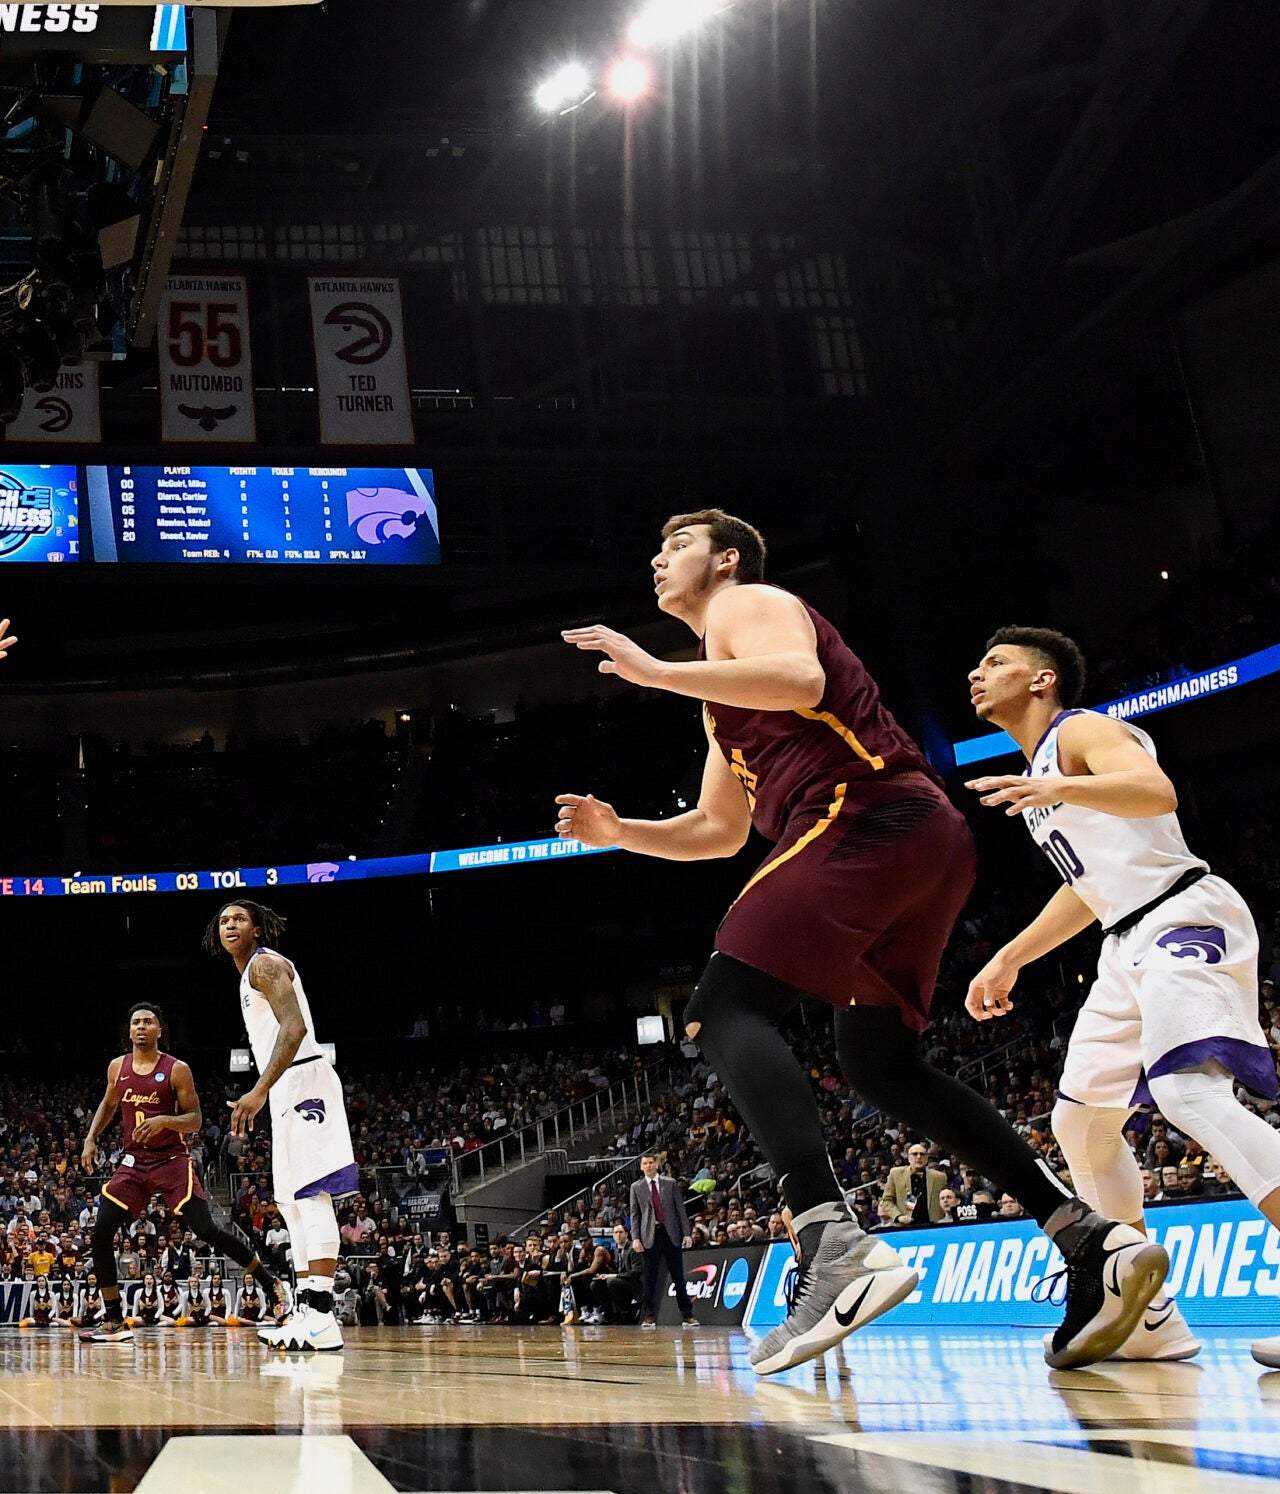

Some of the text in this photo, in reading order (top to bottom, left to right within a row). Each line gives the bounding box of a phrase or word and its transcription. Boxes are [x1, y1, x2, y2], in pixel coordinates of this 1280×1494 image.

[206, 281, 242, 292] HAWKS
[314, 282, 395, 294] ATLANTA HAWKS
[169, 302, 243, 368] 55
[170, 374, 243, 393] MUTOMBO
[348, 375, 376, 392] TED
[336, 394, 394, 412] TURNER
[164, 466, 190, 475] PLAYER
[120, 480, 134, 489] 00
[121, 492, 134, 502] 02
[122, 506, 134, 515] 05
[123, 518, 134, 528] 14
[122, 532, 136, 542] 20
[182, 550, 202, 558] Team
[1107, 666, 1238, 719] #MARCHMADNESS
[458, 848, 509, 867] WELCOME
[512, 846, 526, 860] TO
[528, 844, 548, 858] THE
[24, 878, 44, 894] 14
[62, 878, 106, 894] Team
[112, 876, 157, 892] Fouls
[176, 874, 199, 890] 03
[210, 872, 246, 889] TOL
[266, 868, 278, 886] 3
[122, 1088, 160, 1106] Loyola
[956, 1204, 978, 1217] POSS
